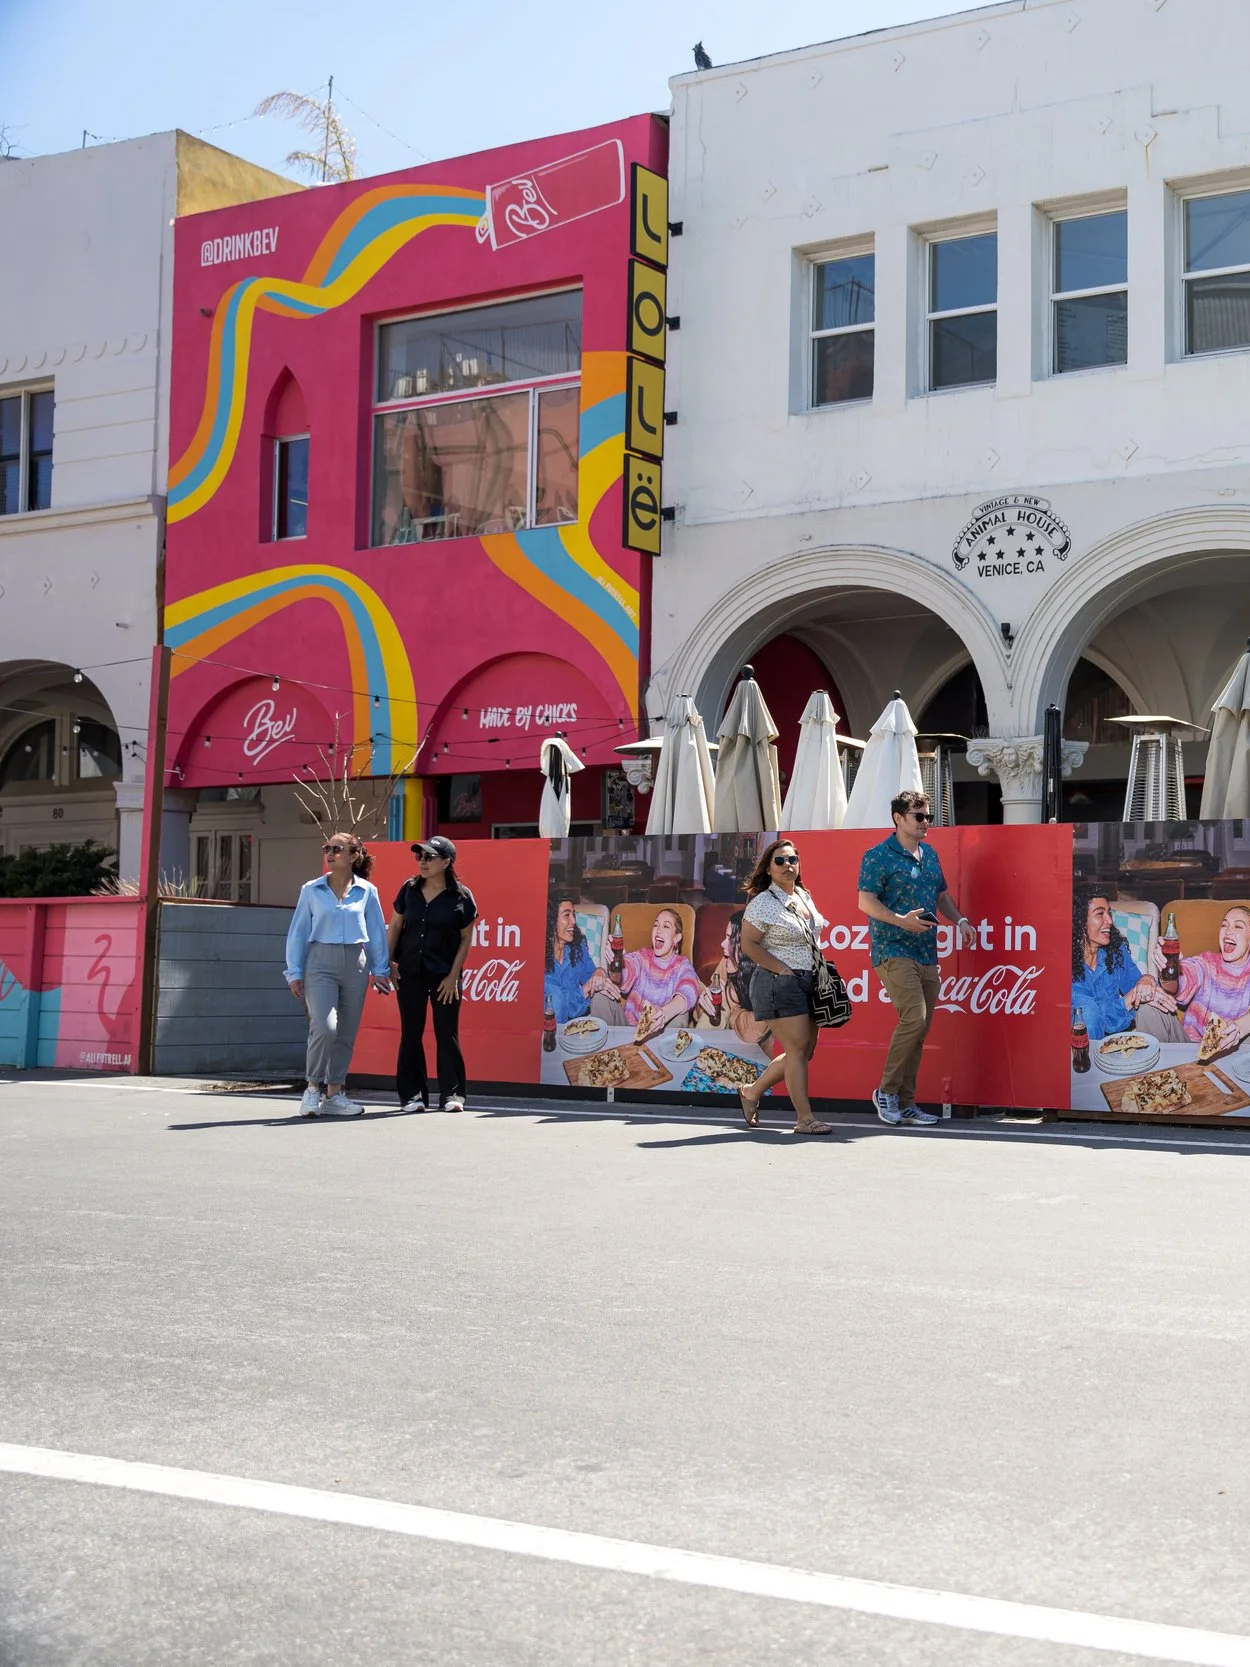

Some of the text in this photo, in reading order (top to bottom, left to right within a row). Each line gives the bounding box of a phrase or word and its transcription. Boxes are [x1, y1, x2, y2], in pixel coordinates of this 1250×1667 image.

[506, 179, 550, 238] Bev
[201, 226, 279, 267] @DRINKBEV
[979, 496, 1041, 513] VINTAGE & NEW
[965, 510, 1060, 548] ANIMAL HOUSE
[977, 560, 1045, 578] VENICE, CA
[243, 699, 297, 758] Bev
[480, 702, 578, 732] MADE BY CHICKS
[497, 916, 521, 948] in
[1004, 915, 1037, 951] in
